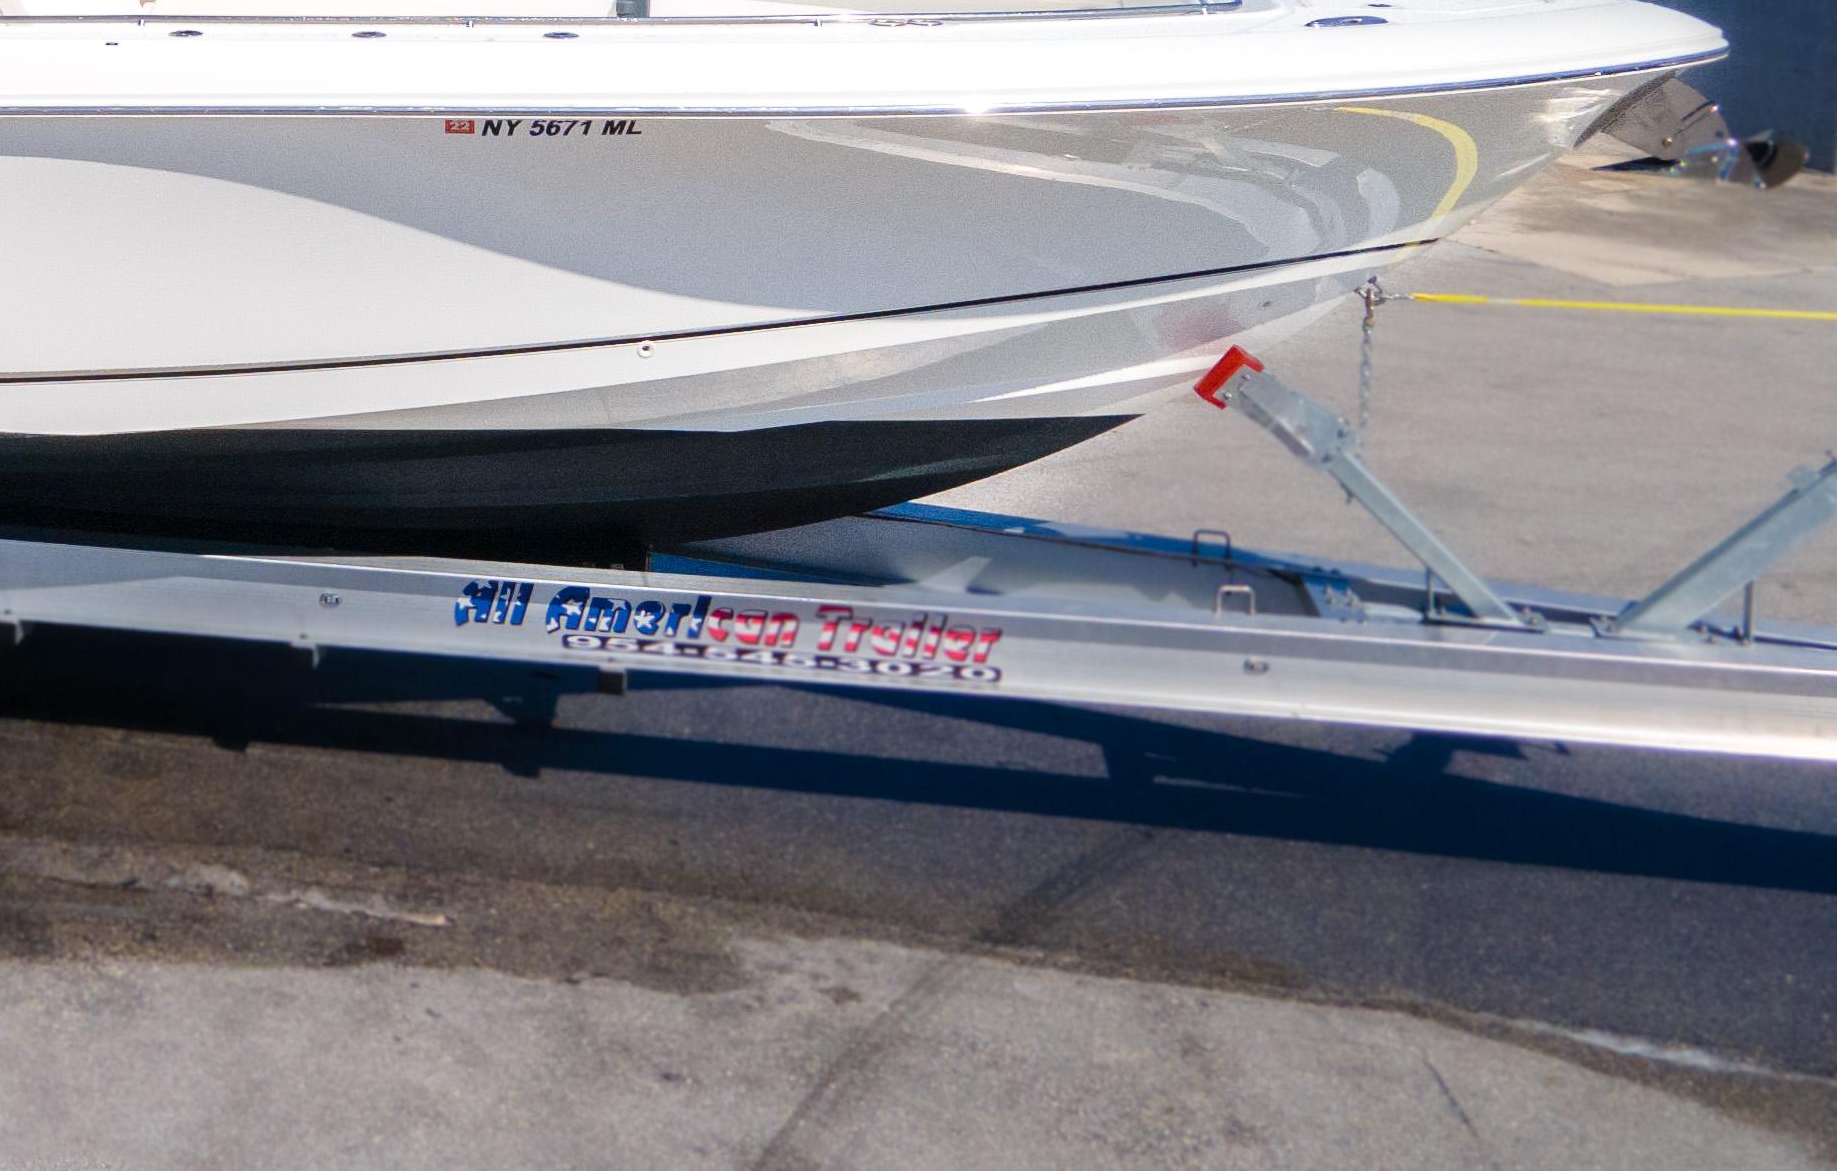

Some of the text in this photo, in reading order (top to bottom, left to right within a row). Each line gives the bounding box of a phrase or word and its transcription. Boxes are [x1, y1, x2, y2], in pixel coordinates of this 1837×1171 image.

[481, 119, 643, 136] NY 5671 ML
[454, 579, 1003, 663] All American Trailer
